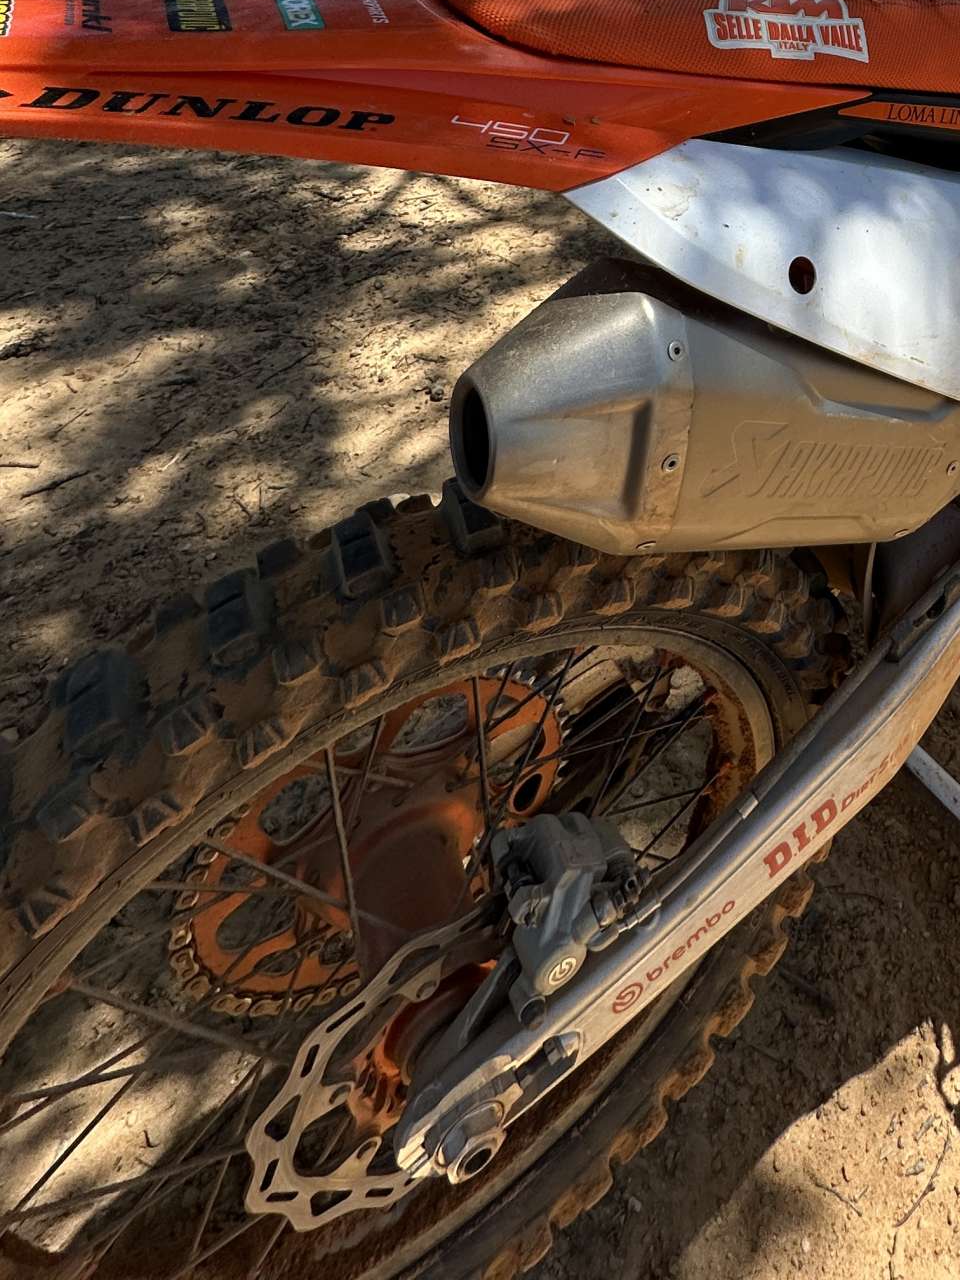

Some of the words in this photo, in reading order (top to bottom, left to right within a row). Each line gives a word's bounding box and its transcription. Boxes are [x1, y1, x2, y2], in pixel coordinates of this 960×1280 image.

[713, 13, 763, 40] SELLE
[767, 21, 817, 42] DALLA
[819, 23, 863, 52] VALLE
[778, 41, 808, 51] ITALY
[20, 86, 396, 131] DUNLOP
[887, 104, 935, 123] LOMA
[451, 115, 570, 145] 450
[486, 137, 608, 159] SX-F
[646, 900, 736, 981] brembo
